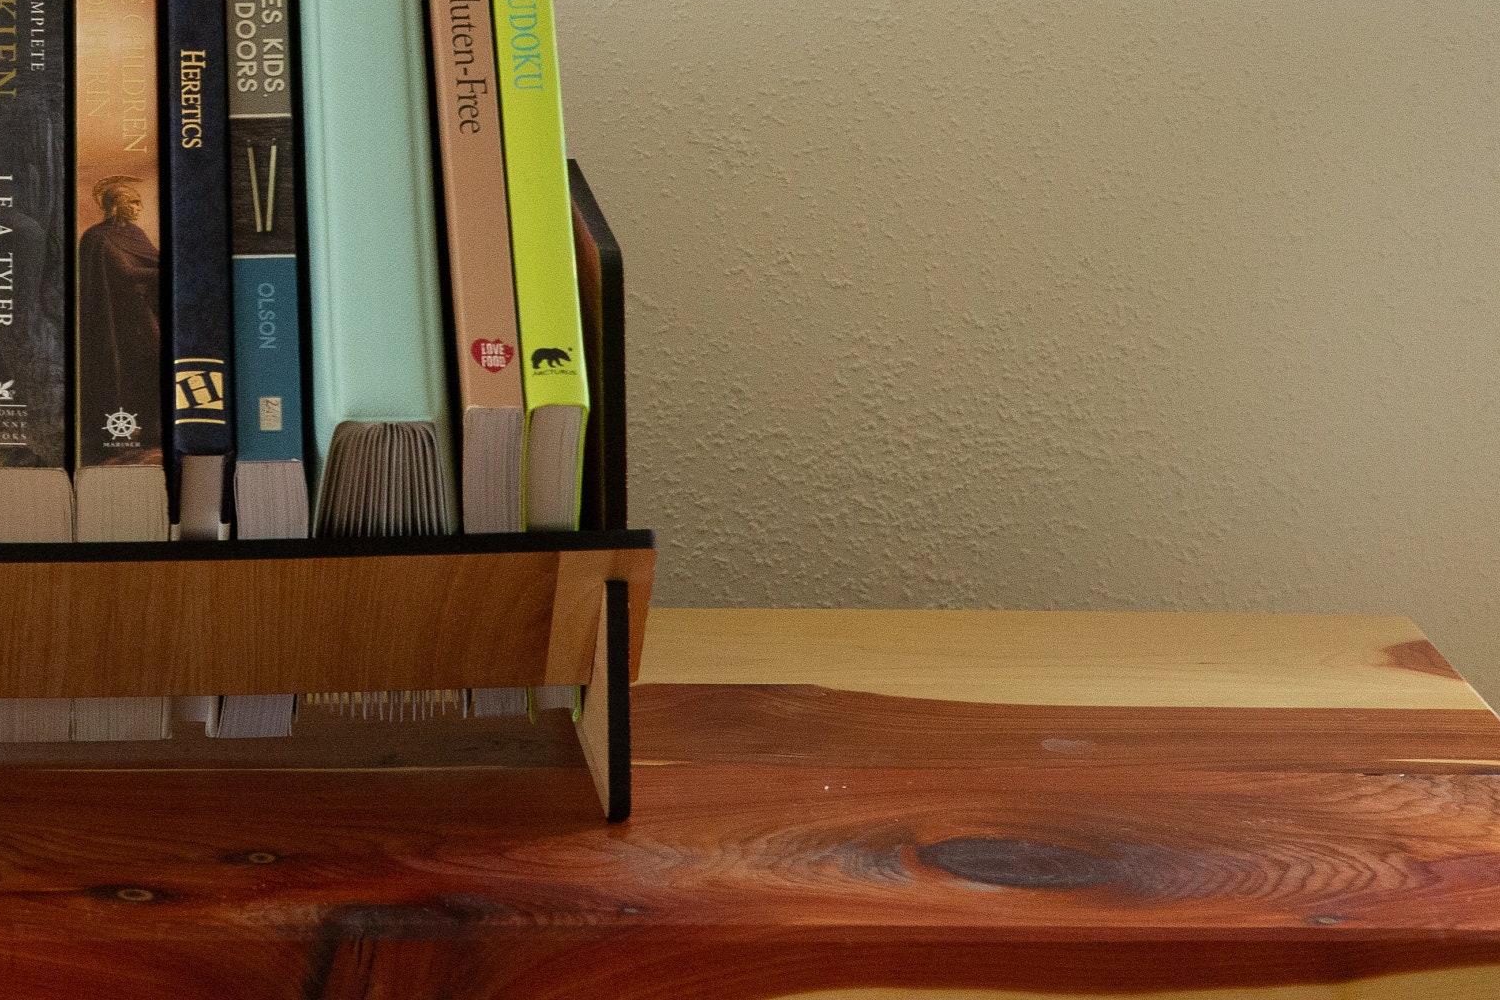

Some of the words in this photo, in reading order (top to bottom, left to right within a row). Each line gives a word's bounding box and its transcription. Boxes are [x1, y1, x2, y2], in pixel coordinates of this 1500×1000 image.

[121, 14, 148, 154] CHILDREN
[262, 37, 285, 97] KIDS,
[257, 282, 278, 350] OLSON
[481, 343, 505, 355] LOVE
